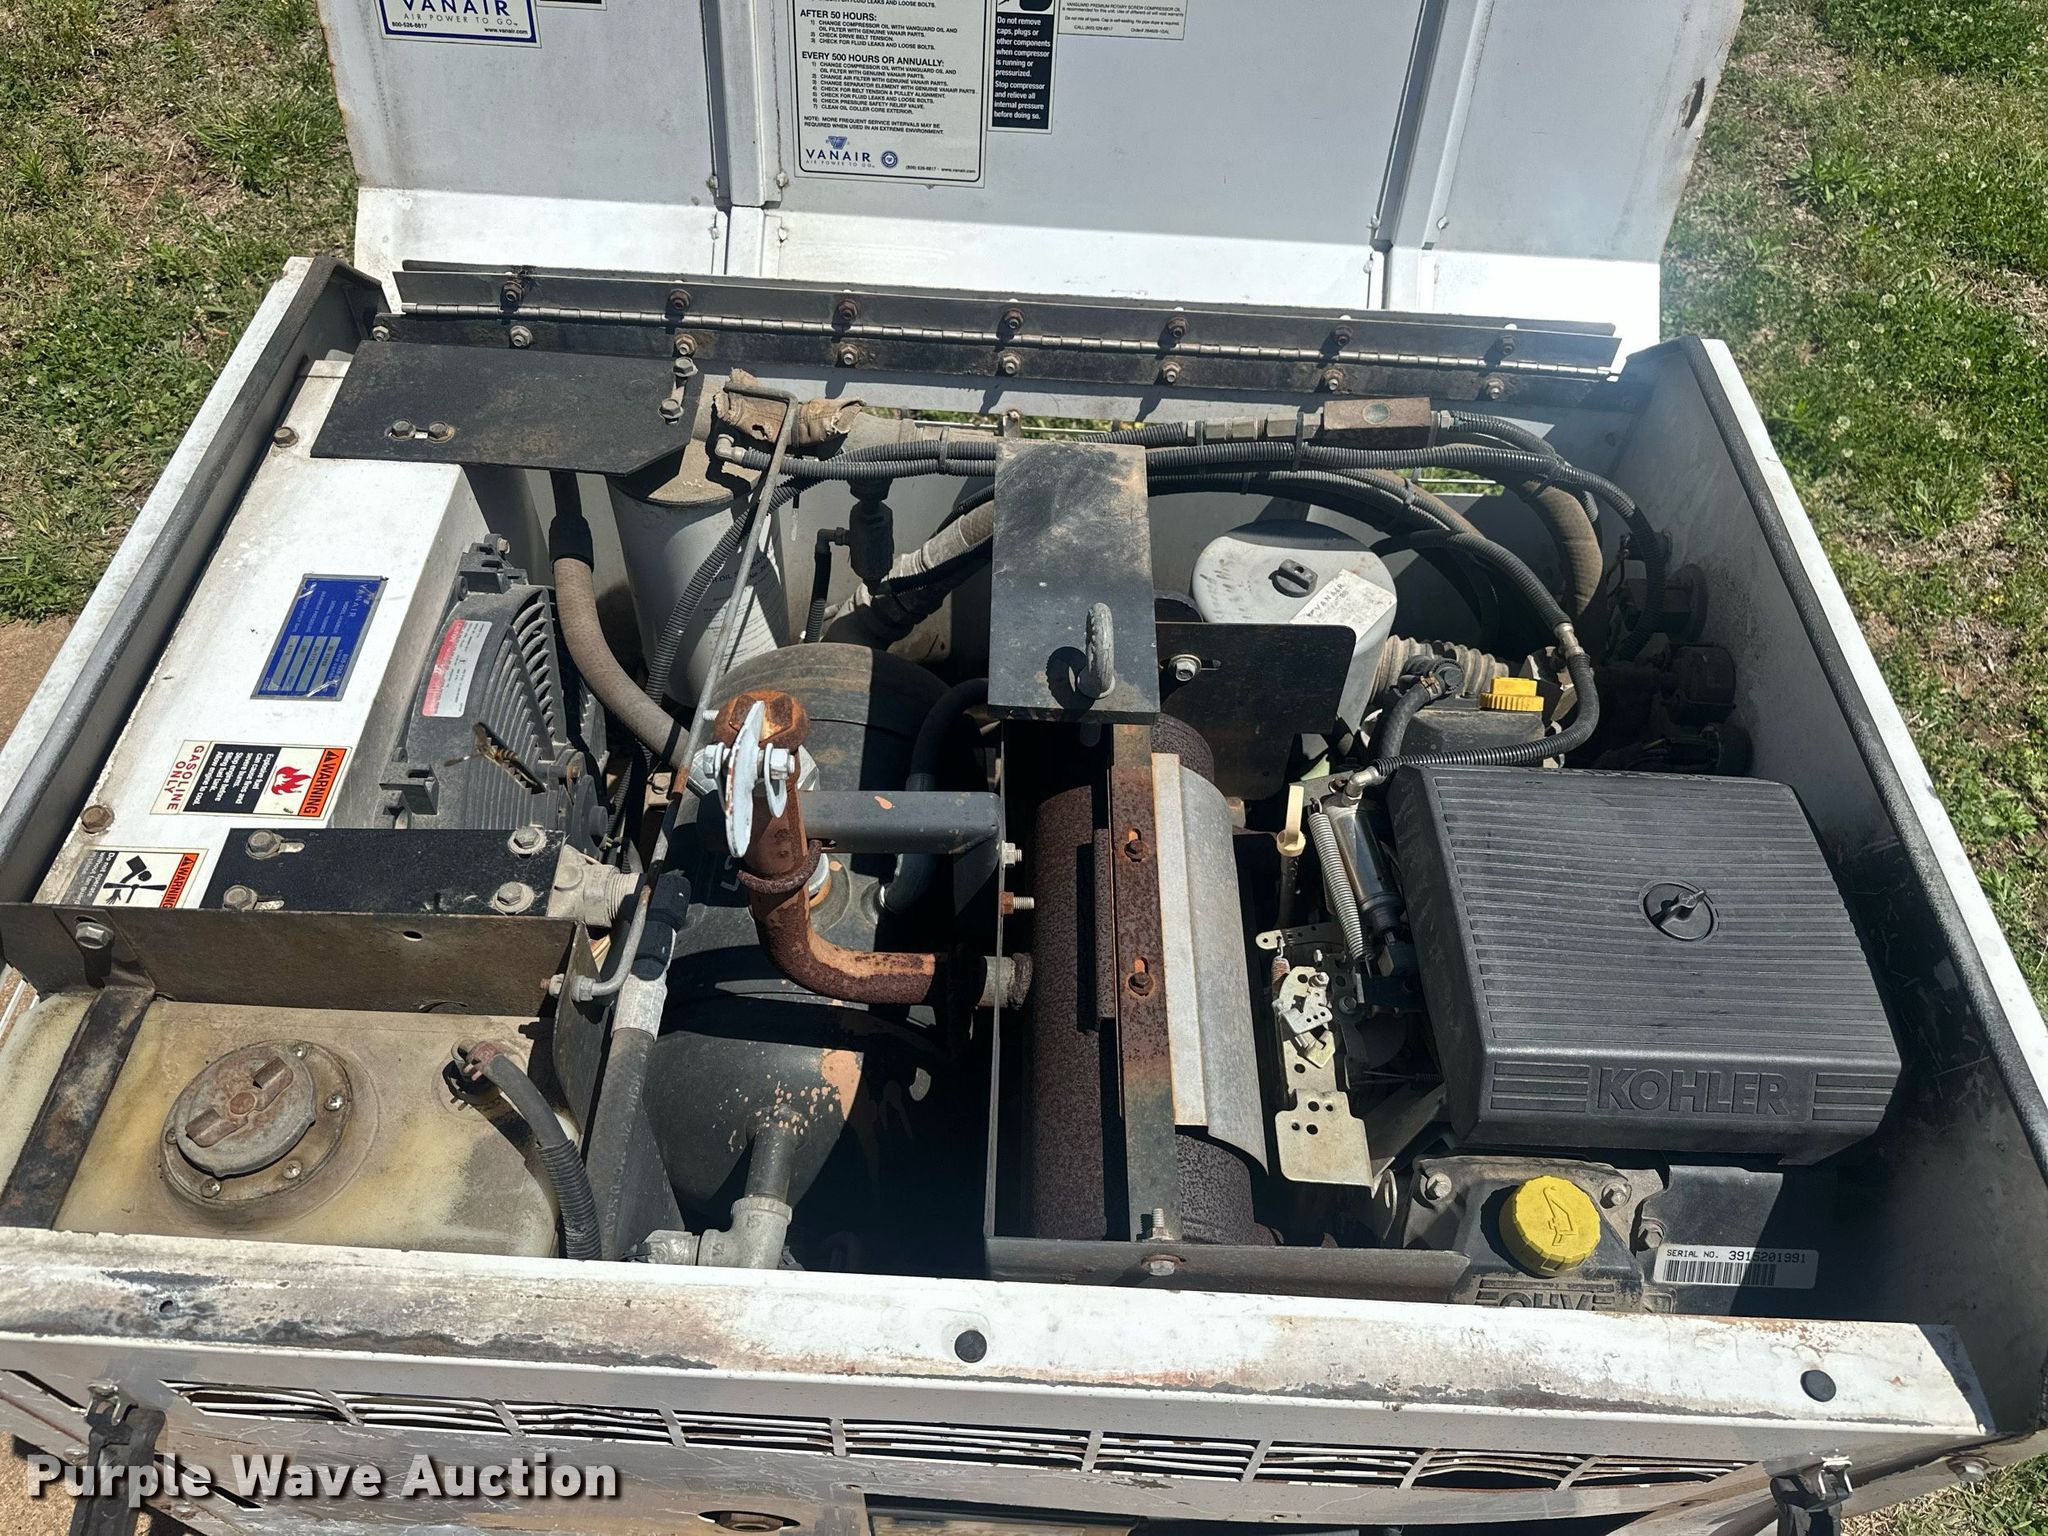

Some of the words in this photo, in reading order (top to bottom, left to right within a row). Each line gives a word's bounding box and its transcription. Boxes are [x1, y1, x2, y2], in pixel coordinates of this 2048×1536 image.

[403, 0, 510, 16] VANAIR
[800, 9, 828, 18] AFTER
[831, 11, 840, 19] 50
[843, 12, 877, 21] HOURS:
[430, 15, 468, 23] POWER
[997, 16, 1006, 24] Do
[1014, 28, 1031, 37] plugs
[802, 51, 831, 60] EVERY
[832, 53, 846, 61] 500
[849, 54, 880, 63] HOURS
[882, 56, 895, 64] OR
[897, 57, 944, 67] ANNUALLY:
[1003, 59, 1026, 68] running
[995, 69, 1032, 77] pressurized.
[995, 81, 1009, 89] Stop
[1010, 82, 1045, 90] compressor
[1014, 112, 1031, 120] doing
[806, 149, 870, 162] VANAIR
[348, 584, 367, 618] VANAIR
[211, 751, 224, 767] Allow
[232, 752, 243, 764] Stop
[241, 753, 253, 770] severe
[254, 753, 263, 763] can
[216, 767, 227, 777] fuel
[247, 764, 258, 779] cause
[257, 754, 274, 778] Explosive
[164, 761, 186, 793] ONLY
[166, 745, 205, 811] GASOLINE
[202, 766, 215, 785] engine
[223, 765, 236, 783] engine
[232, 771, 247, 788] burns.
[209, 778, 221, 792] tank.
[252, 779, 263, 789] fuel
[303, 763, 333, 814] WARNING
[215, 784, 229, 801] before
[235, 793, 245, 804] and
[106, 852, 115, 861] Do
[100, 862, 109, 872] not
[87, 873, 103, 897] operate
[162, 868, 188, 908] WARNING
[1597, 1067, 1790, 1115] KOHLER
[1667, 1250, 1698, 1258] SERIAL
[1728, 1250, 1806, 1263] 3915201991
